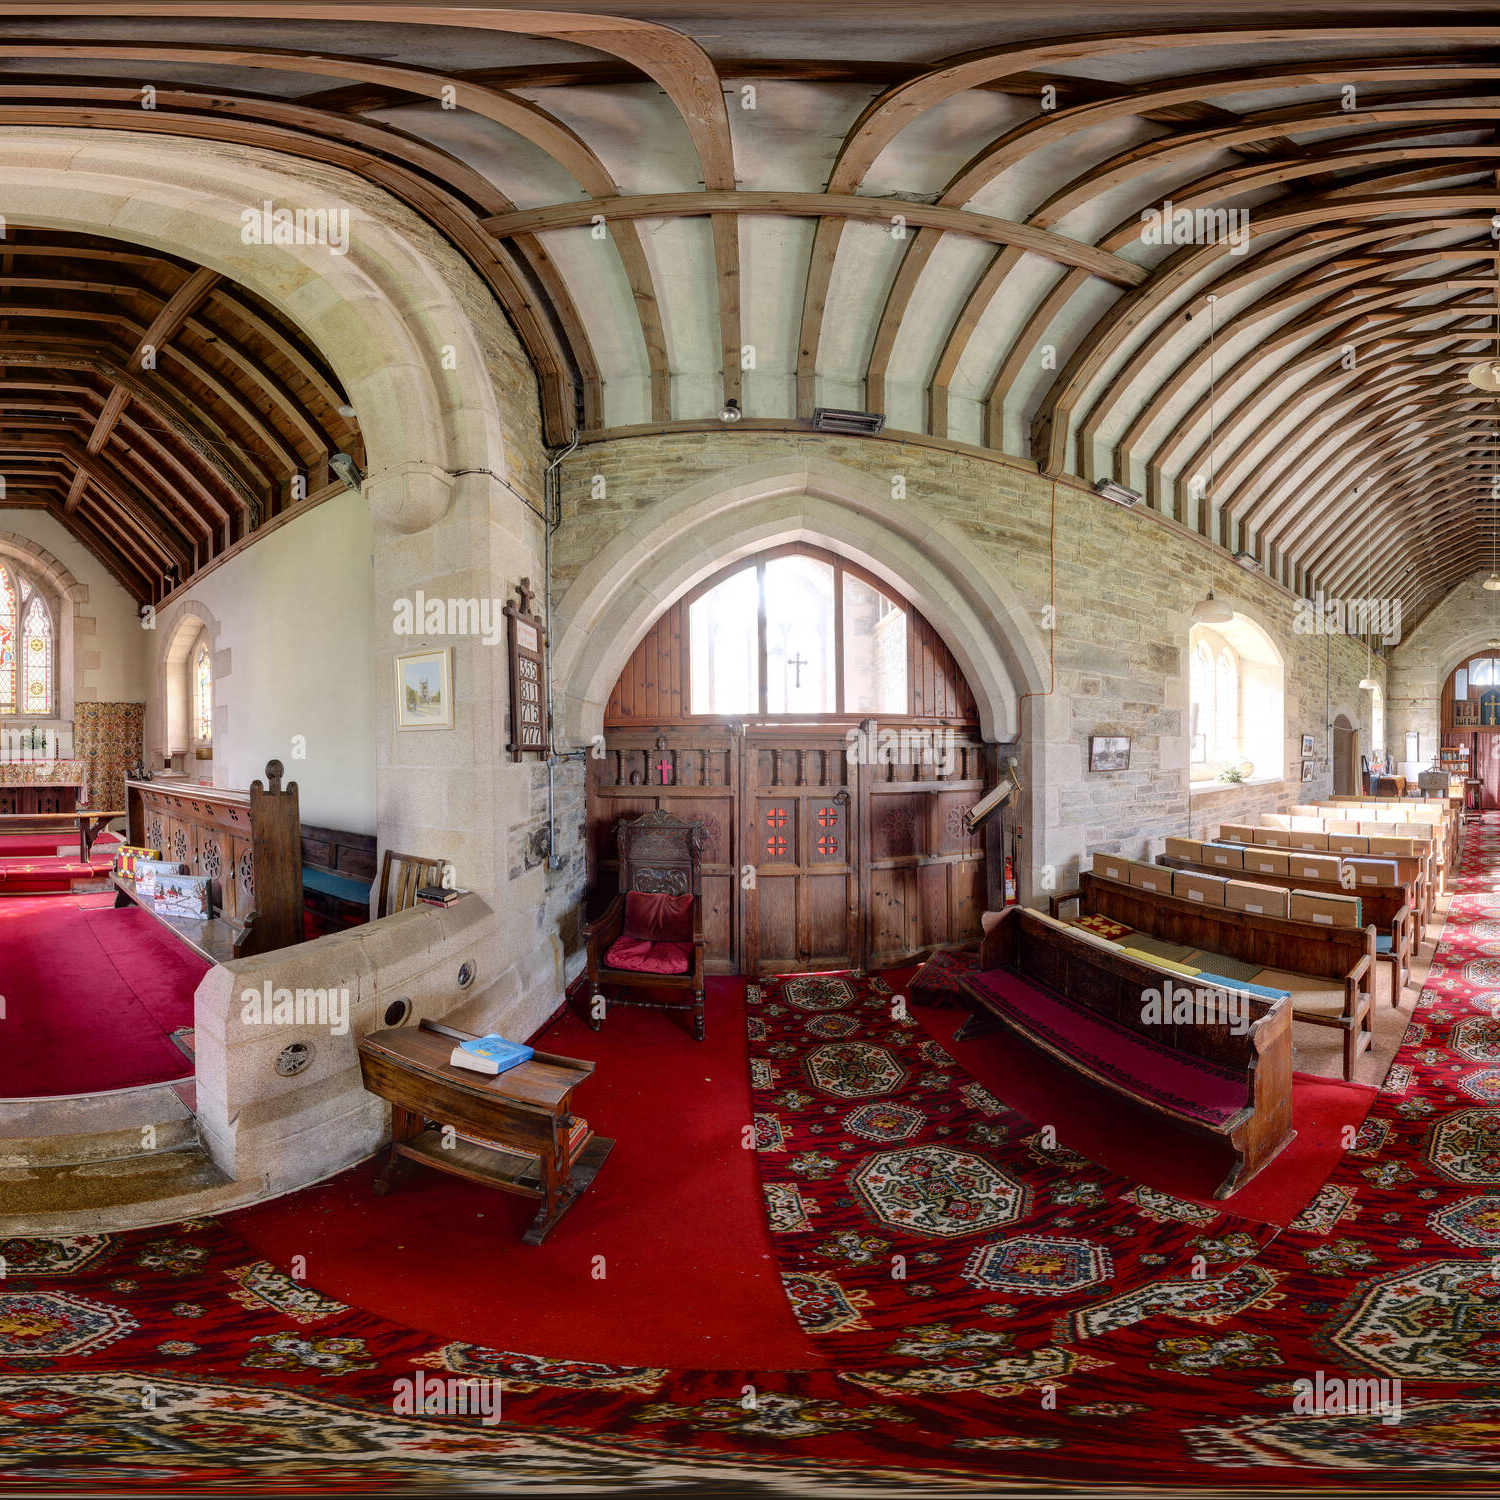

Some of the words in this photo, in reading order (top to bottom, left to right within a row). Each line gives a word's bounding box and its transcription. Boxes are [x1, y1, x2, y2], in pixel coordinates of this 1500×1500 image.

[520, 659, 536, 680] 355
[521, 680, 537, 702] 811
[522, 703, 538, 722] 715
[523, 726, 540, 743] 777
